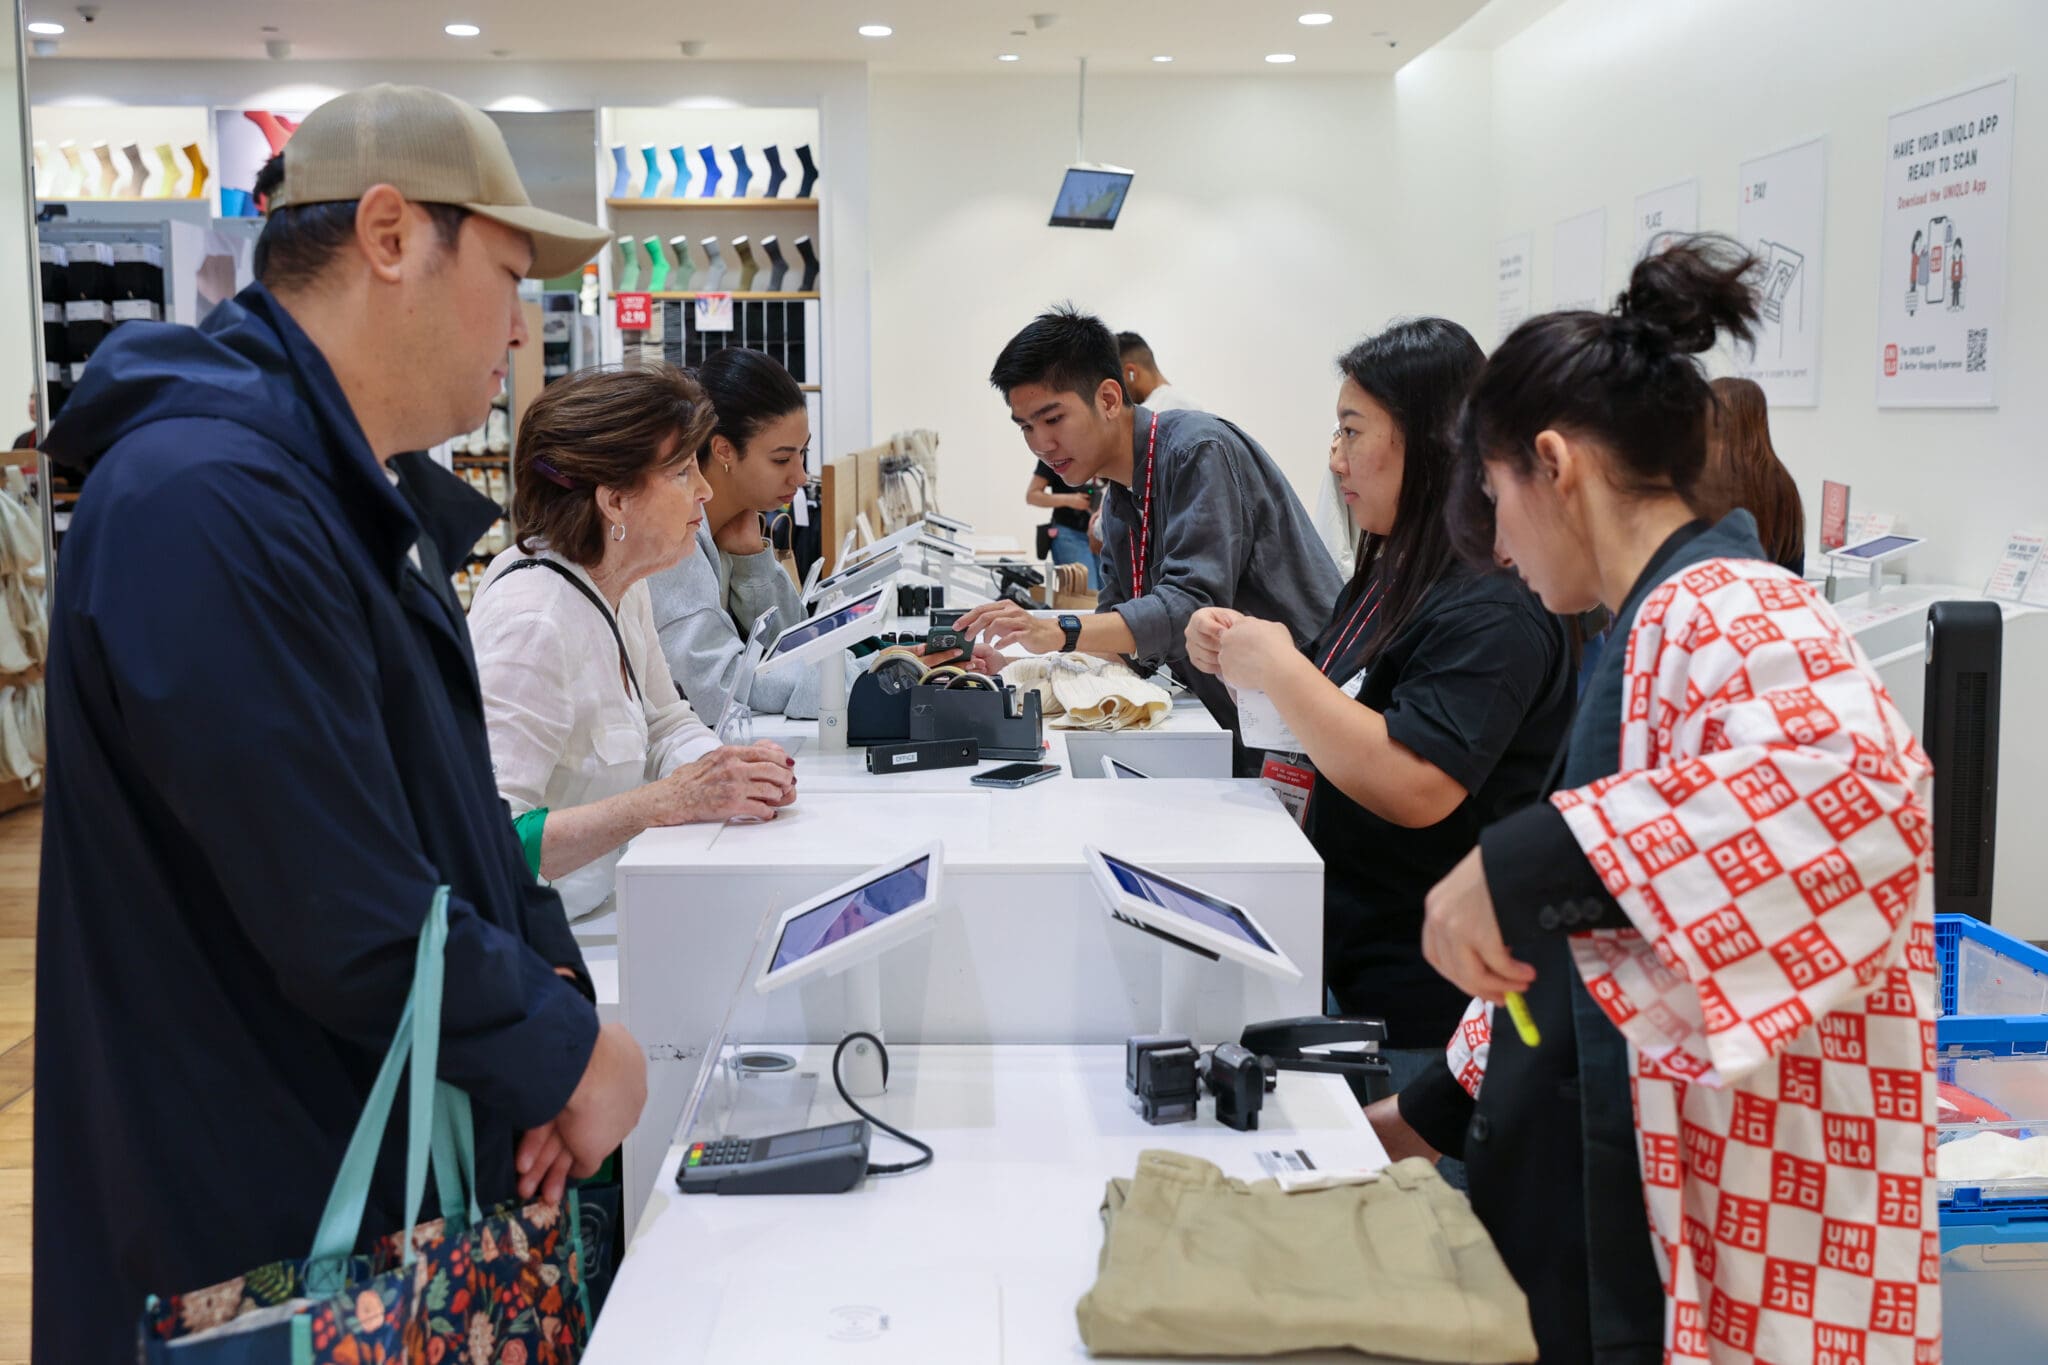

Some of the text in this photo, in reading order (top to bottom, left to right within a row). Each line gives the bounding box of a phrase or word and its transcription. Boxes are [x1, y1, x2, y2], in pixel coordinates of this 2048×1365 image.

[1893, 114, 1999, 160] HAVE YOUR UNIQLO APP
[1908, 148, 1978, 182] READY TO SCAN
[1897, 179, 1986, 209] Download the UNIQLO App
[895, 754, 915, 763] OFFICE
[1729, 761, 1777, 797] QLO
[1747, 782, 1792, 816] UNI
[1630, 817, 1678, 852] QLO
[1643, 834, 1692, 870] UNI
[1799, 854, 1847, 889] QLO
[1813, 873, 1858, 908] UNI
[1691, 911, 1741, 946] QLO
[1908, 927, 1936, 948] UN
[1706, 930, 1756, 965] UNI
[1909, 947, 1936, 969] QL
[1465, 1018, 1487, 1034] UN
[1755, 1003, 1804, 1039] UNI
[1820, 1015, 1858, 1037] UNI
[1822, 1036, 1862, 1059] QLO
[1827, 1118, 1869, 1142] UNI
[1827, 1141, 1872, 1164] QLO
[1694, 1154, 1718, 1179] LO
[1826, 1223, 1869, 1249] UNI
[1824, 1245, 1871, 1272] QLO
[1677, 1329, 1708, 1354] QL
[1817, 1327, 1859, 1353] UNI
